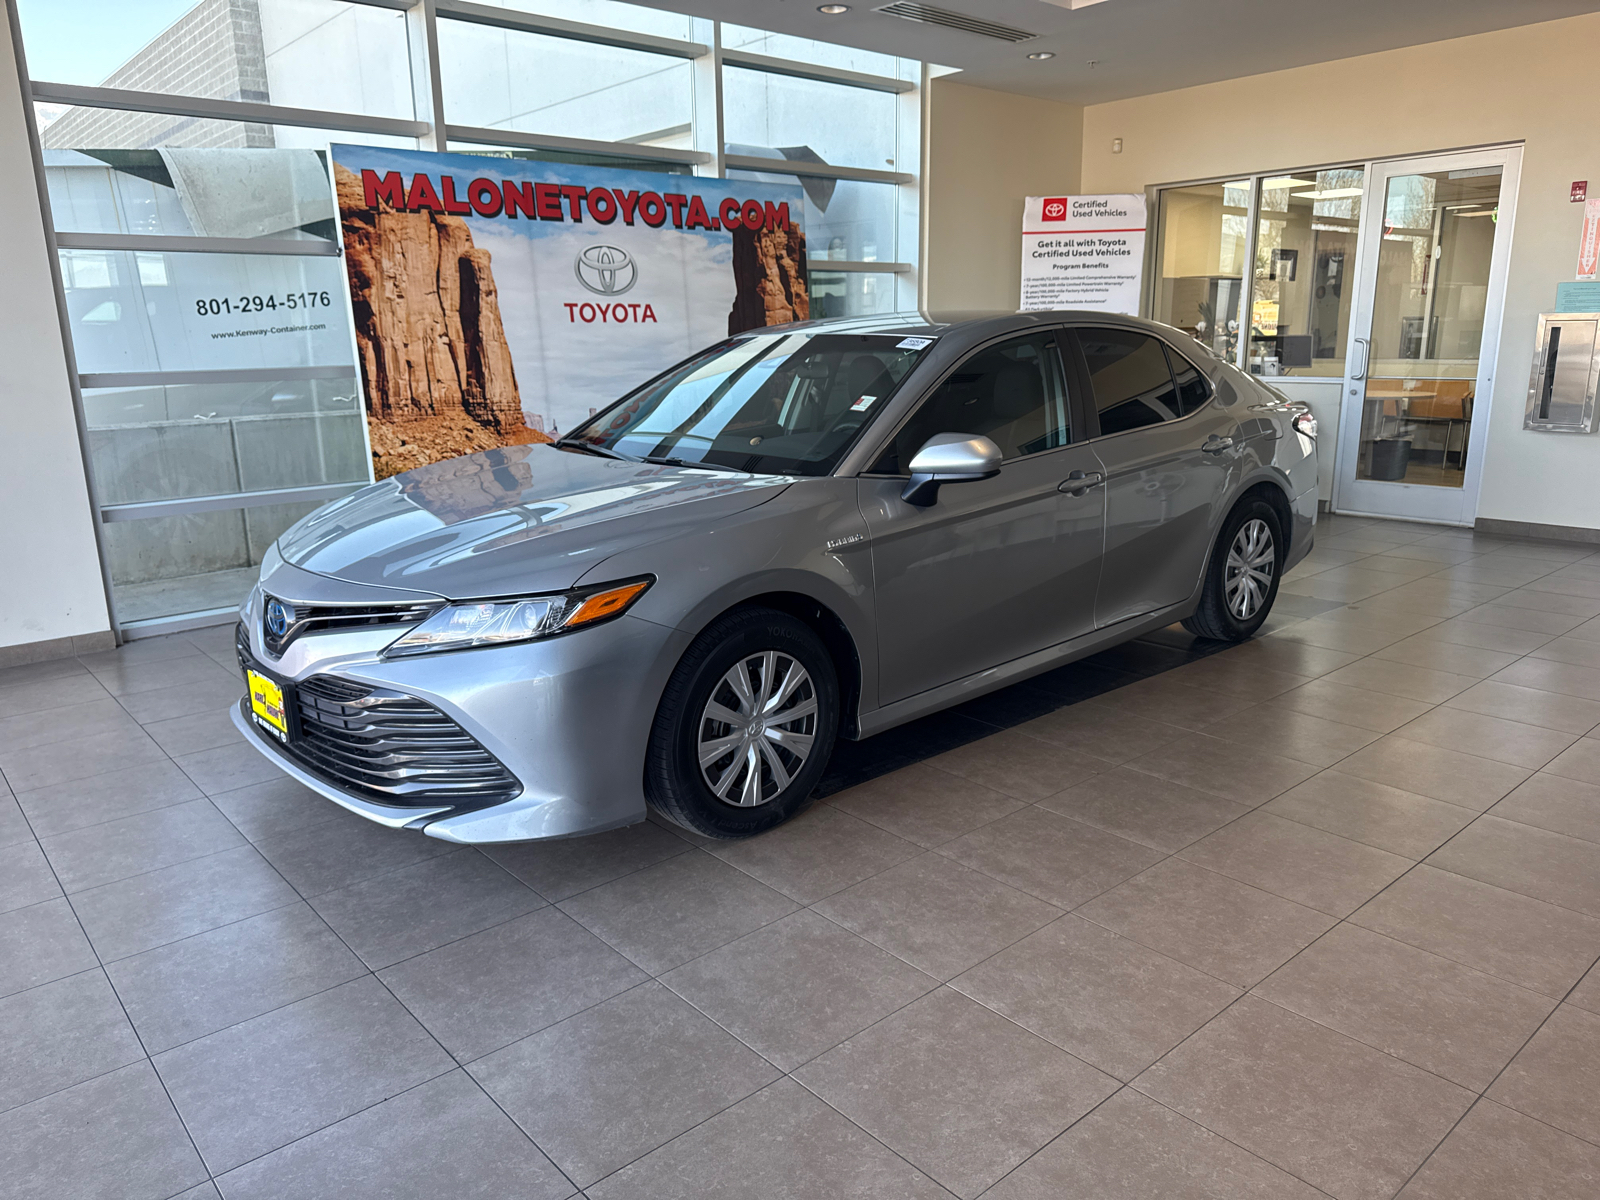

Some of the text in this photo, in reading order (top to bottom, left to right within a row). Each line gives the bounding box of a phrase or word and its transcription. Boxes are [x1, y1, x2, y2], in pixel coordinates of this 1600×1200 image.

[361, 169, 790, 232] MALONETOYOTA.COM
[1073, 200, 1108, 209] Certified
[1072, 209, 1127, 218] Used Vehicles
[1037, 239, 1127, 249] Get it all with Toyota
[1032, 248, 1131, 258] Certified Used Vehicles
[1052, 263, 1081, 271] Program
[196, 291, 331, 316] 801-294-5176
[564, 302, 658, 323] TOYOTA
[211, 323, 326, 340] www.Kenway-Container.com
